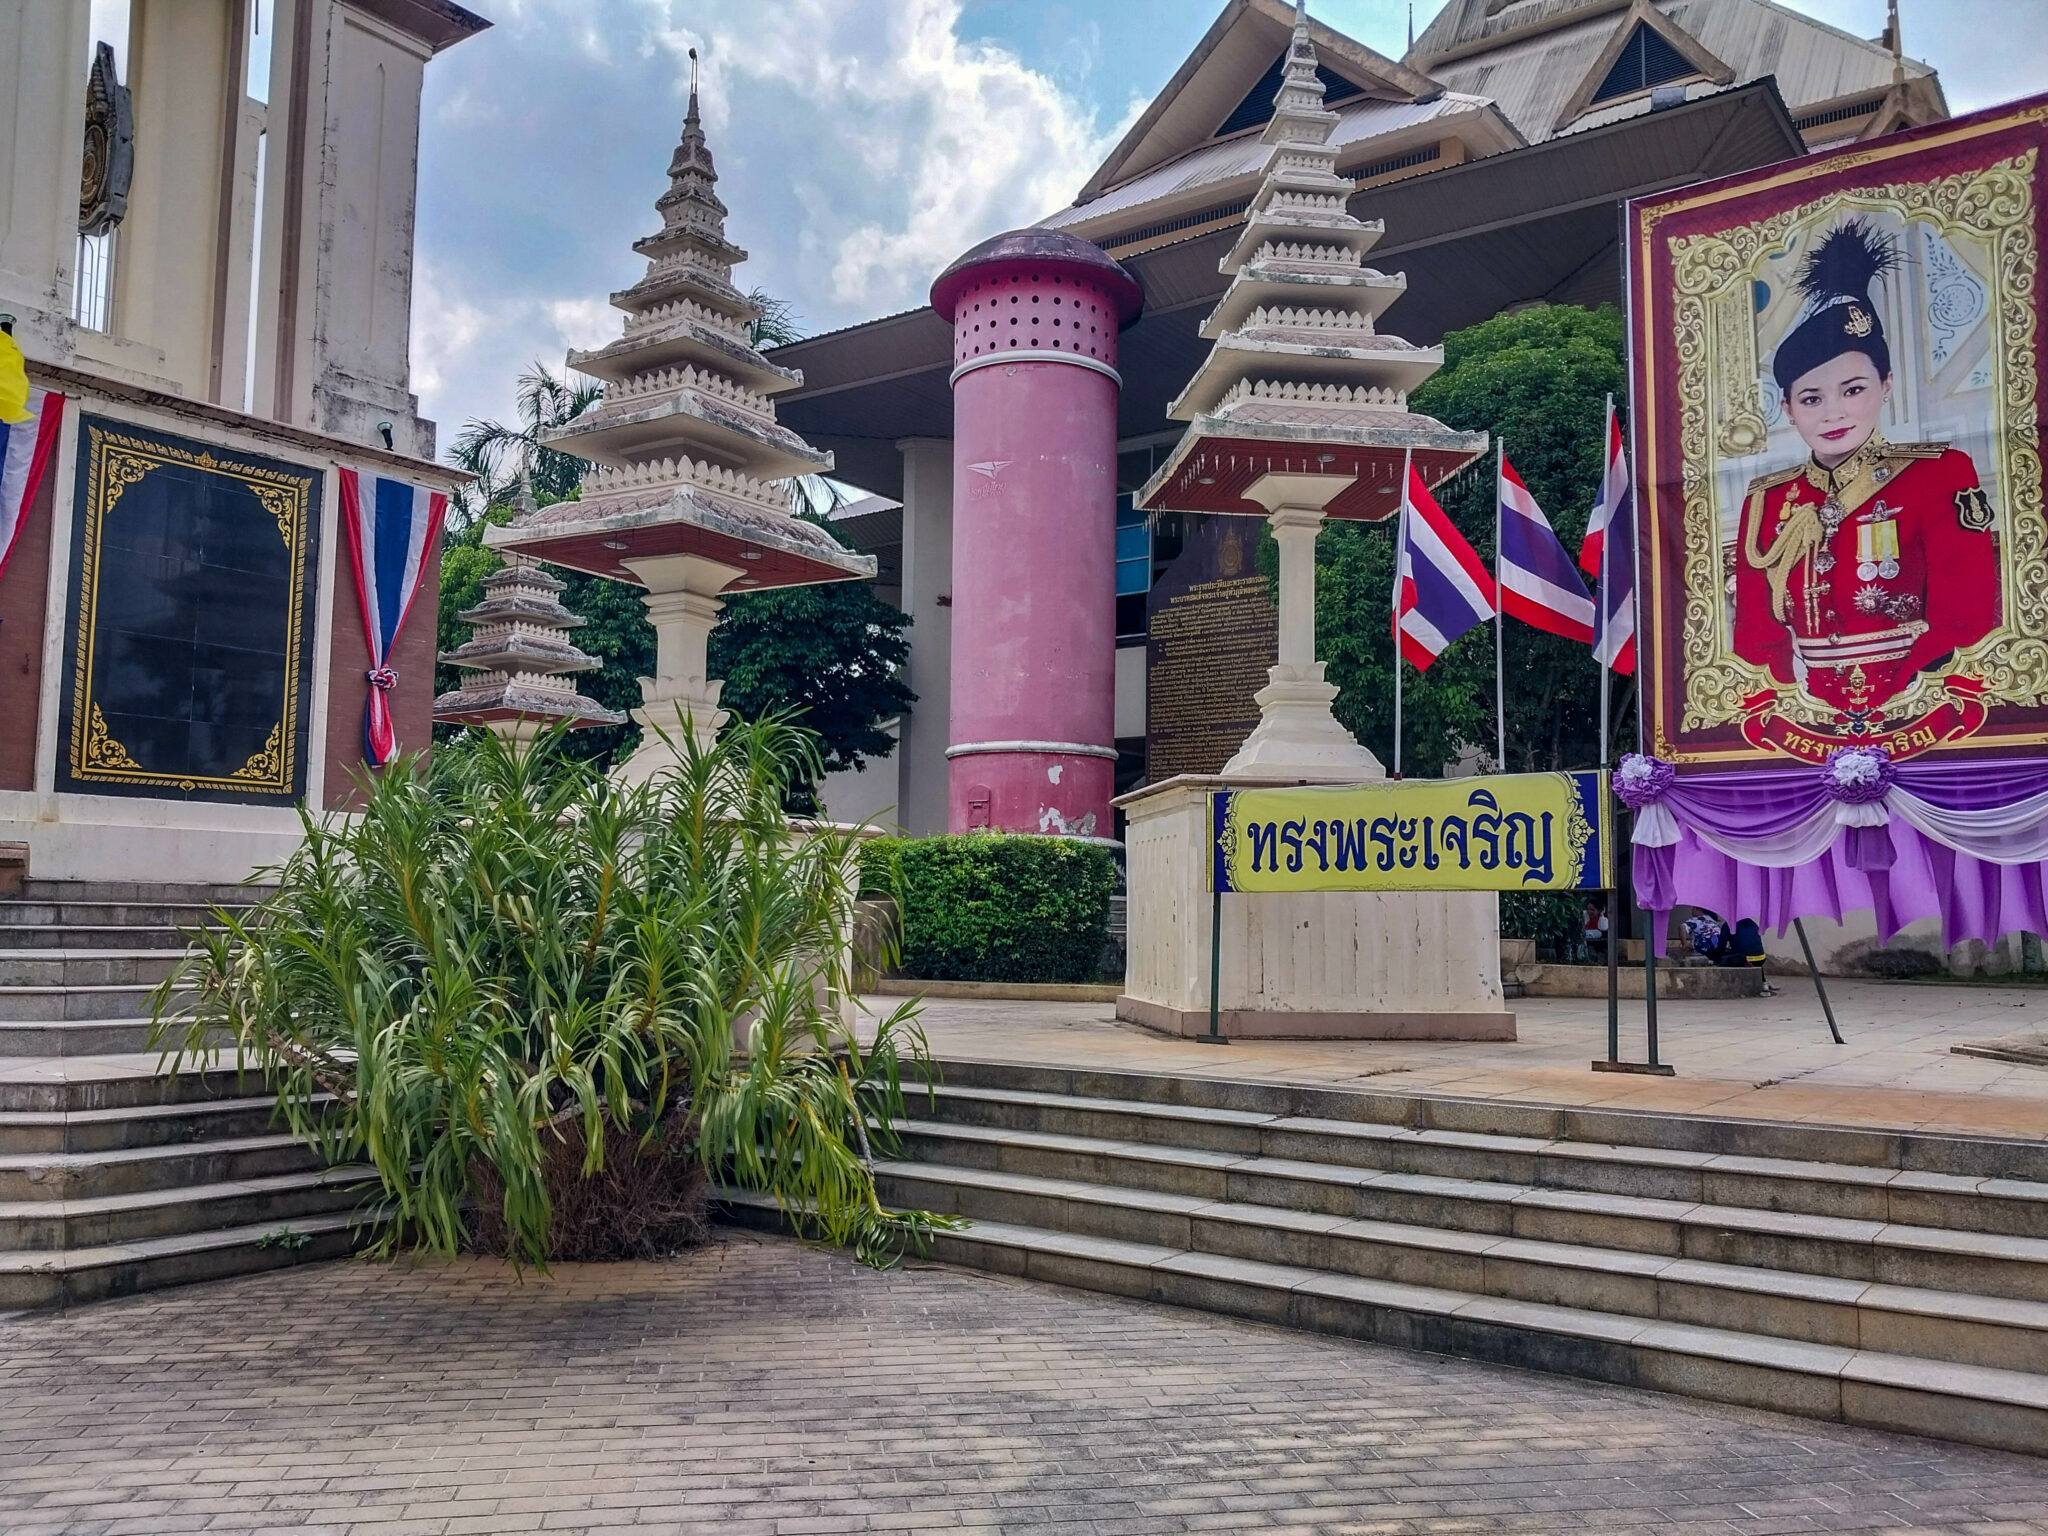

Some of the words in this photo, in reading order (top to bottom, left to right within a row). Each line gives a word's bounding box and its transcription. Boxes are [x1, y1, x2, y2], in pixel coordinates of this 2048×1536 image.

[1247, 789, 1554, 887] ทรงพระเจริญ
